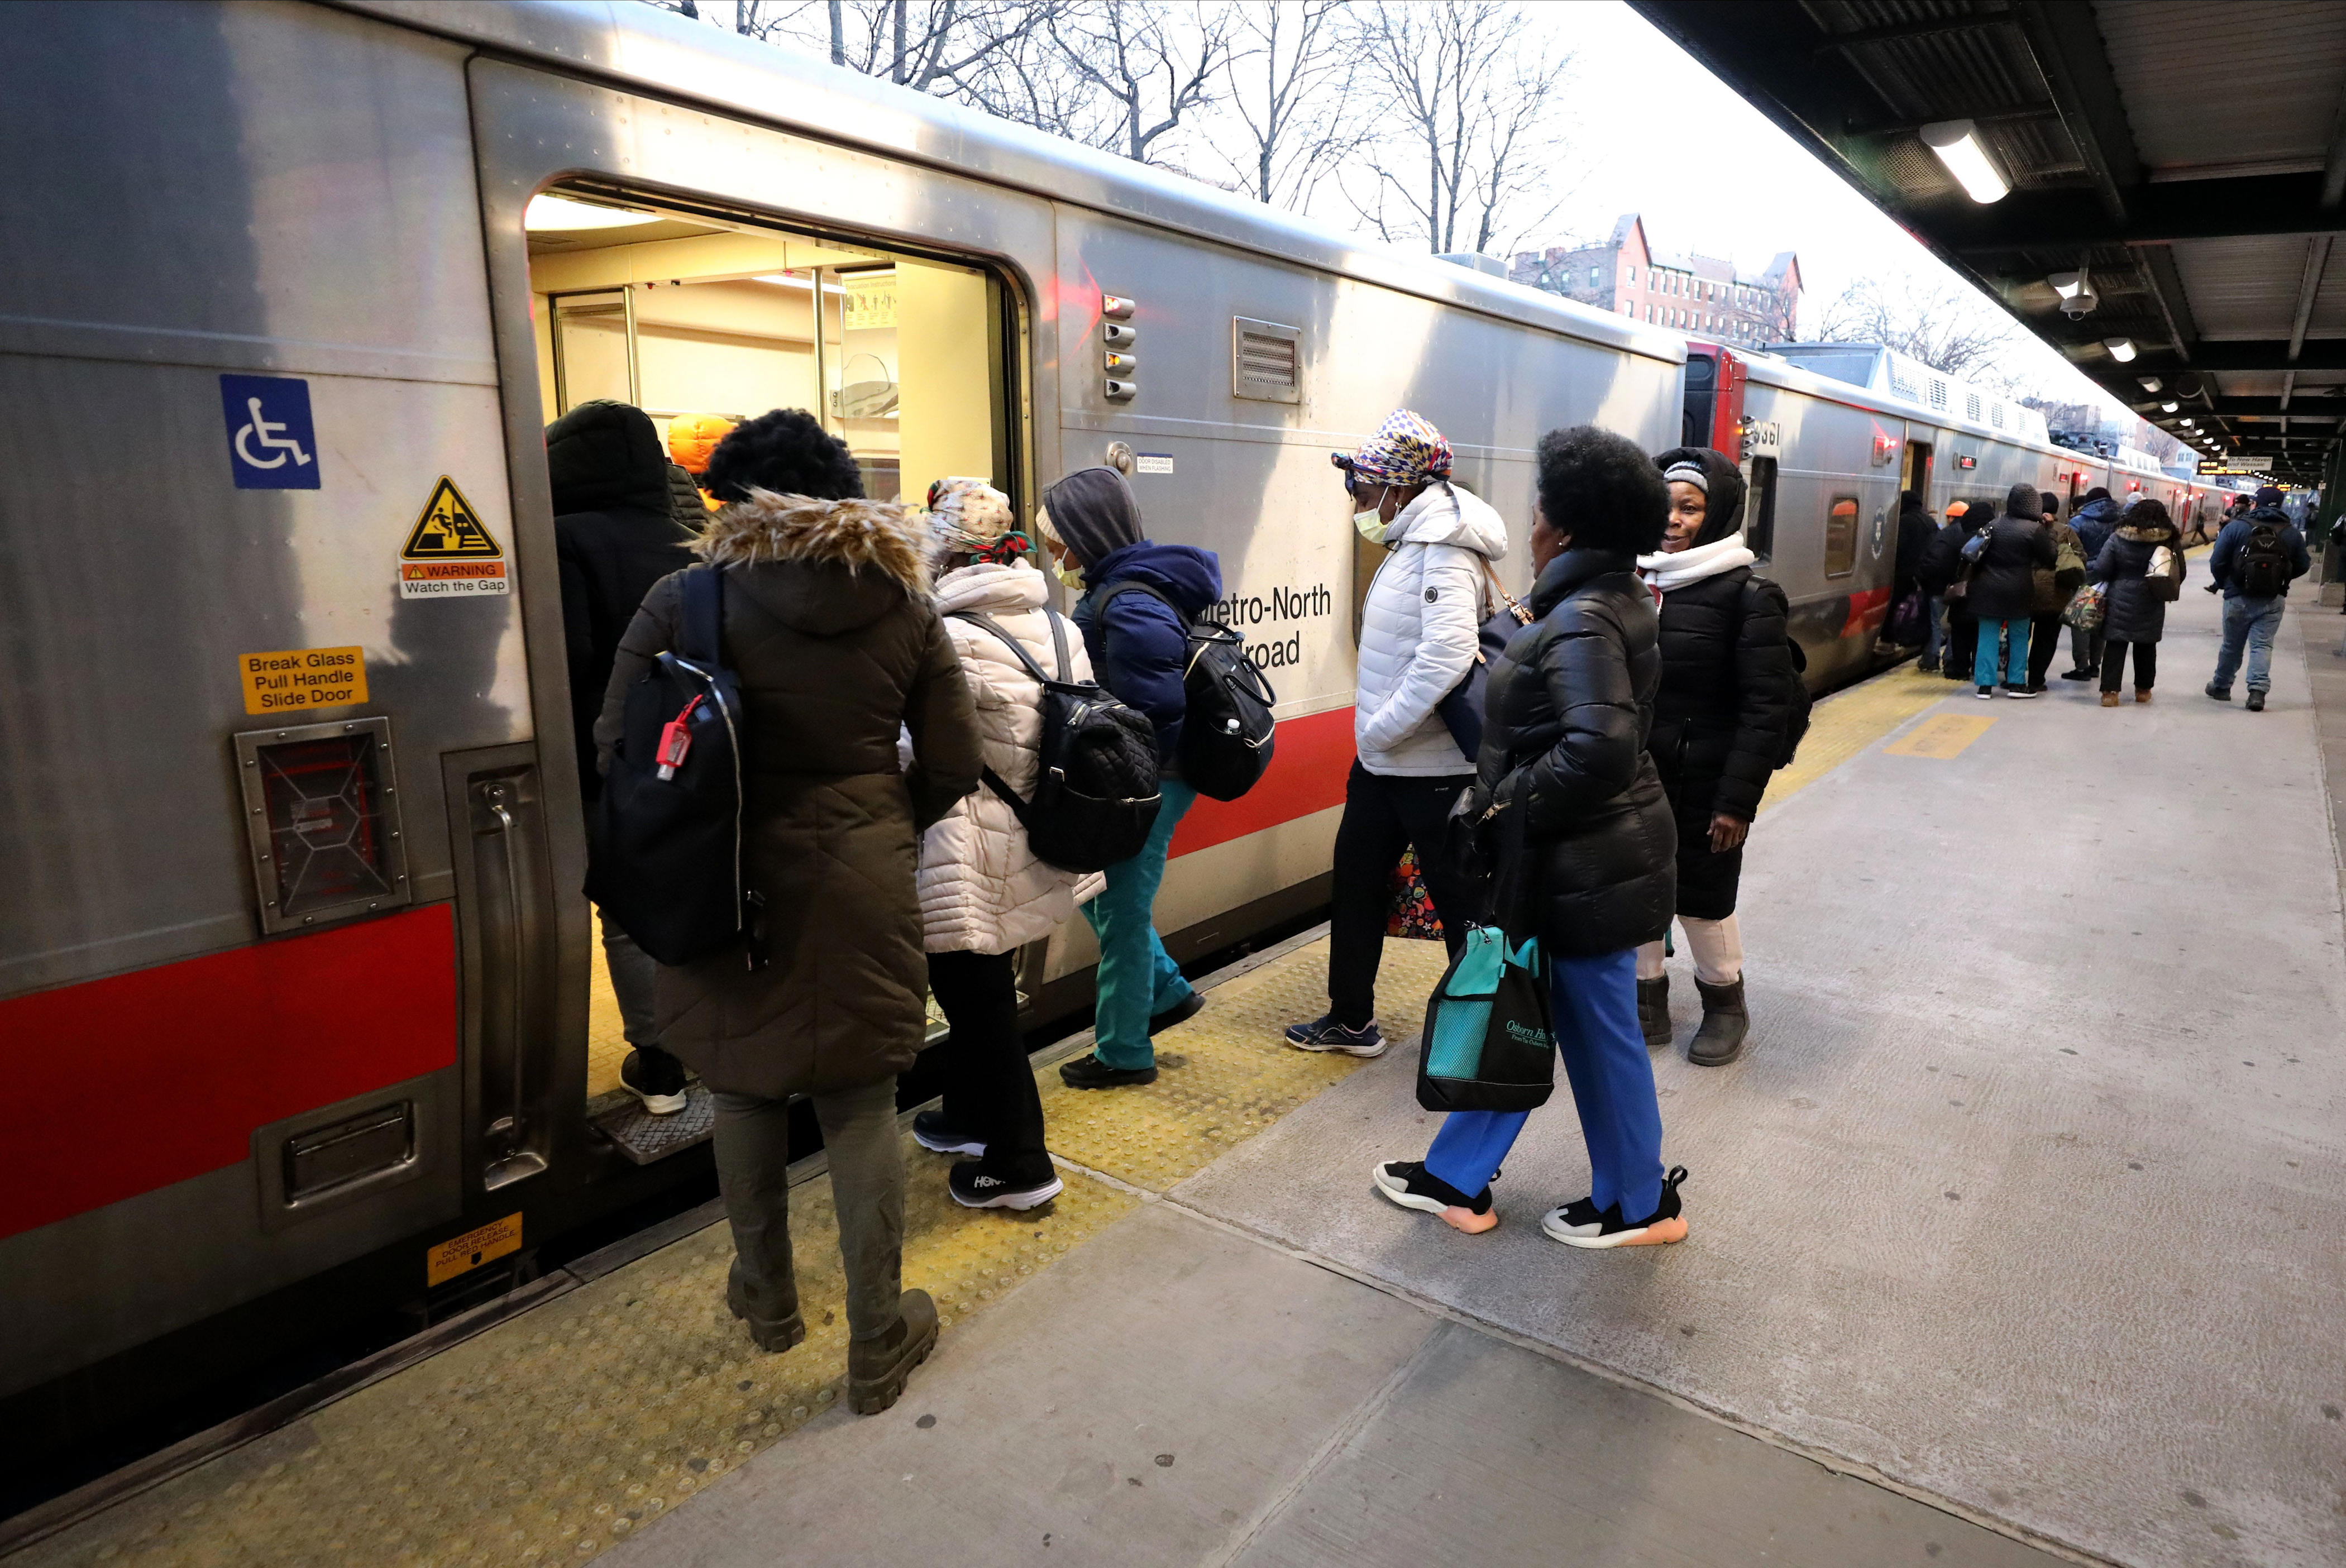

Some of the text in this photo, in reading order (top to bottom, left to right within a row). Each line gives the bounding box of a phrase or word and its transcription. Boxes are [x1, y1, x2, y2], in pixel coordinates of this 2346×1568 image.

[1754, 420, 1780, 446] 9361
[427, 565, 496, 577] WARNING
[405, 580, 505, 593] Watch the Gap
[249, 653, 355, 672] Break Glass
[255, 670, 353, 690] Pull Handle
[261, 689, 353, 707] Slide Door
[1507, 1020, 1533, 1036] Osborn
[442, 1225, 509, 1258] DOOR RELEASE
[448, 1221, 503, 1249] EMERGENCY
[436, 1230, 515, 1267] PULL RED HANDLE
